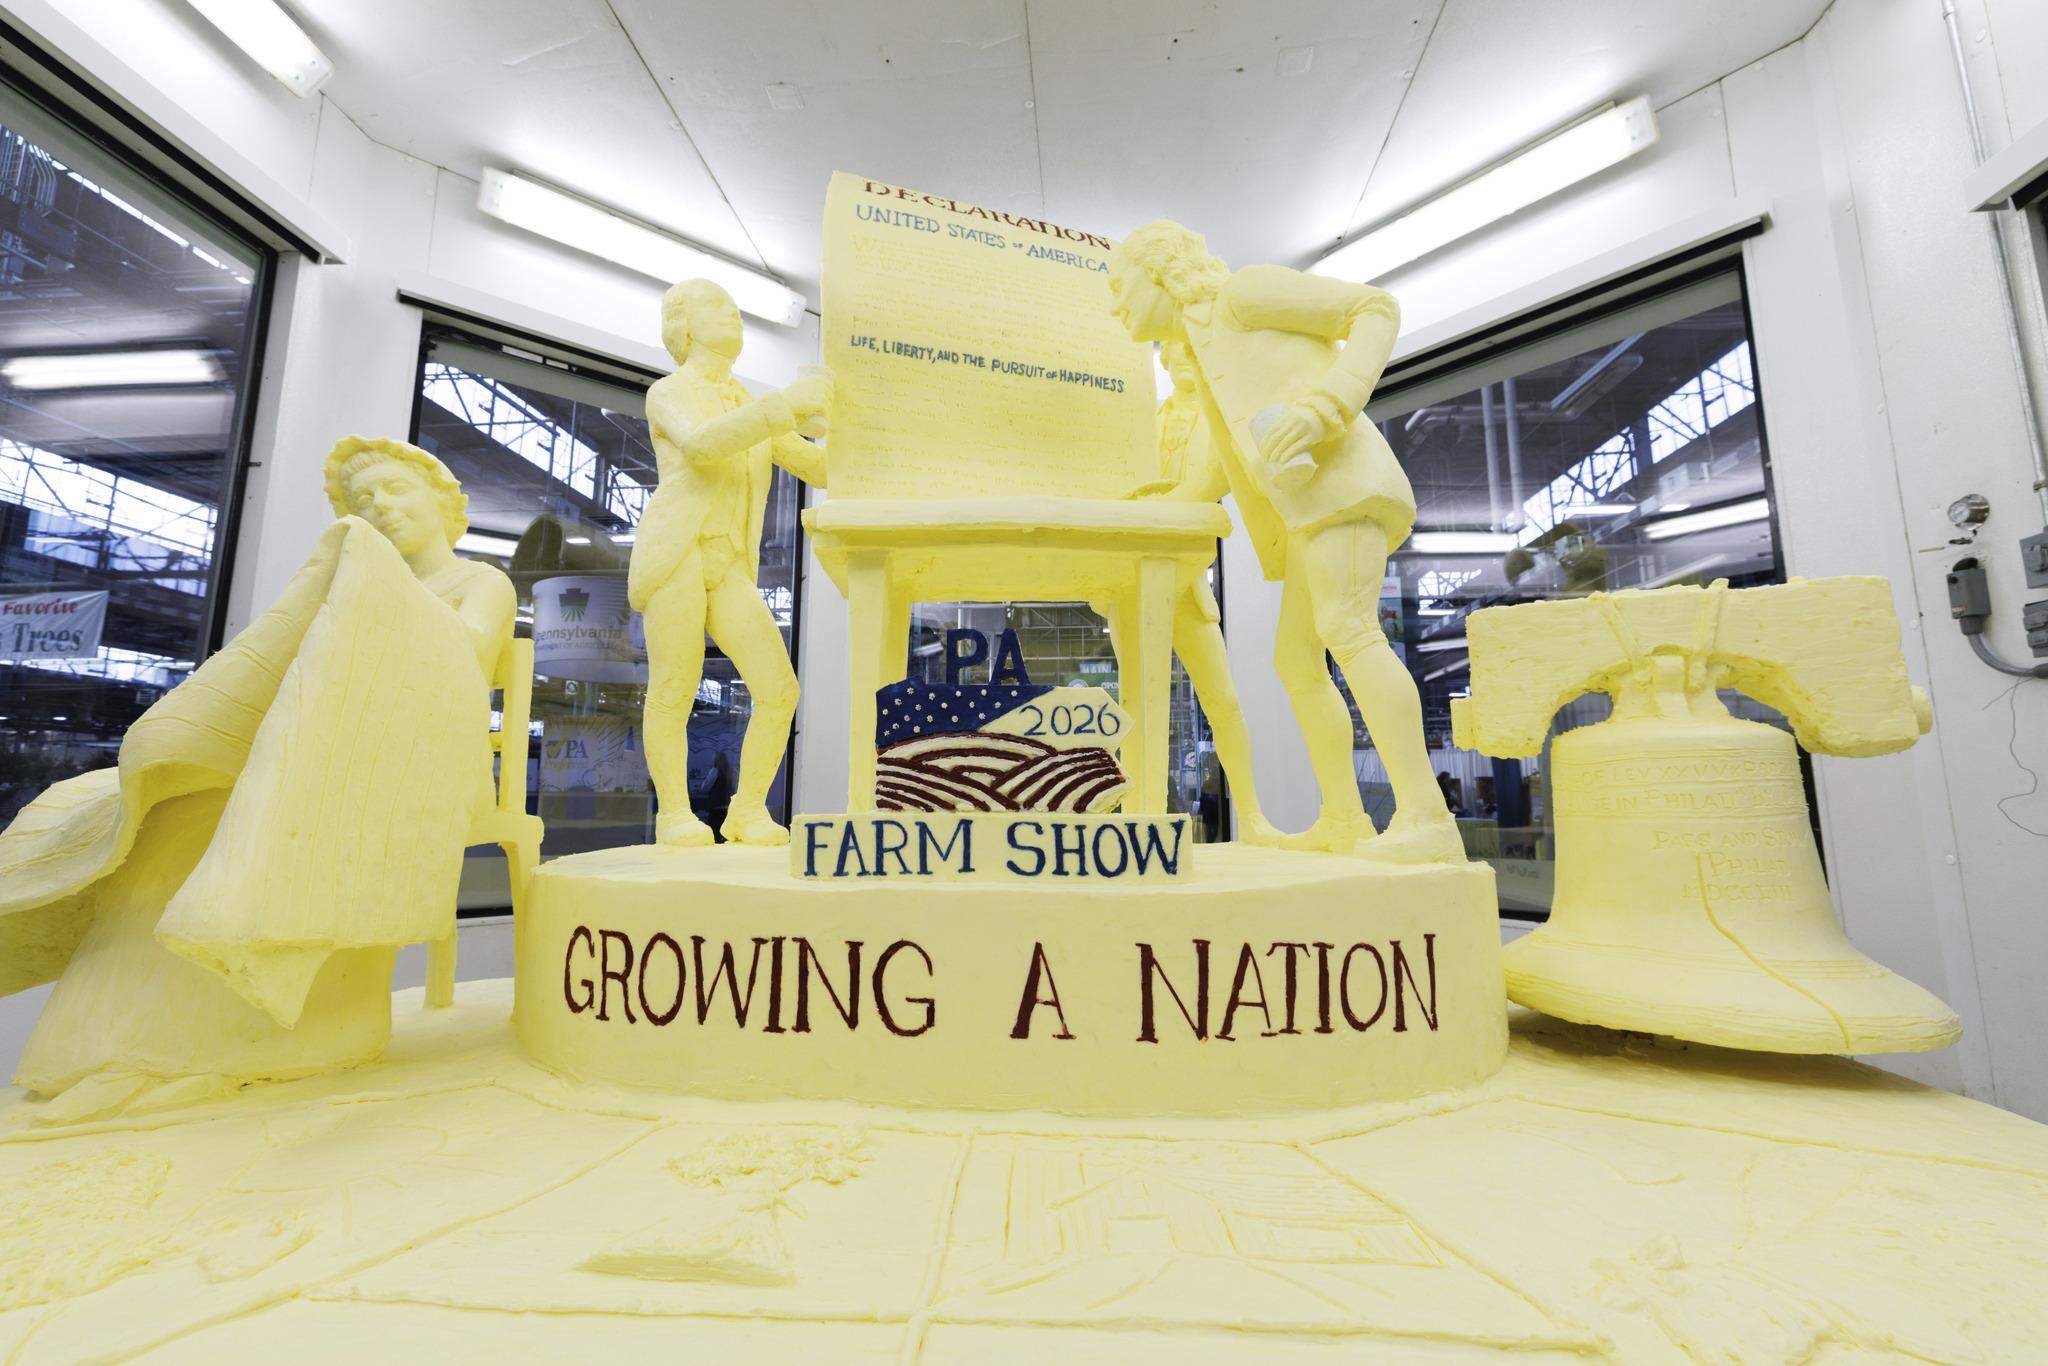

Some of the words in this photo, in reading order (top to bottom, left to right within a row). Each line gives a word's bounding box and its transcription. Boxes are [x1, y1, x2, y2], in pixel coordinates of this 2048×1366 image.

[856, 203, 940, 234] UNITED
[947, 223, 1006, 249] STATES
[1026, 244, 1110, 274] AMERICA
[862, 181, 1112, 251] DECLARATION
[851, 335, 880, 353] LIFE,
[937, 350, 959, 364] AND
[963, 353, 985, 368] THE
[991, 359, 1045, 379] PURSUIT
[1059, 369, 1125, 393] HAPPINESS
[3, 598, 79, 615] Favorite
[12, 623, 83, 652] Trees
[946, 628, 1032, 686] PA
[1019, 703, 1121, 736] 2026
[566, 740, 588, 759] PA
[803, 819, 976, 877] FARM
[1006, 819, 1186, 878] SHOW
[563, 925, 936, 1038] GROWING
[1009, 942, 1077, 1040] A
[1135, 933, 1440, 1044] NATION
